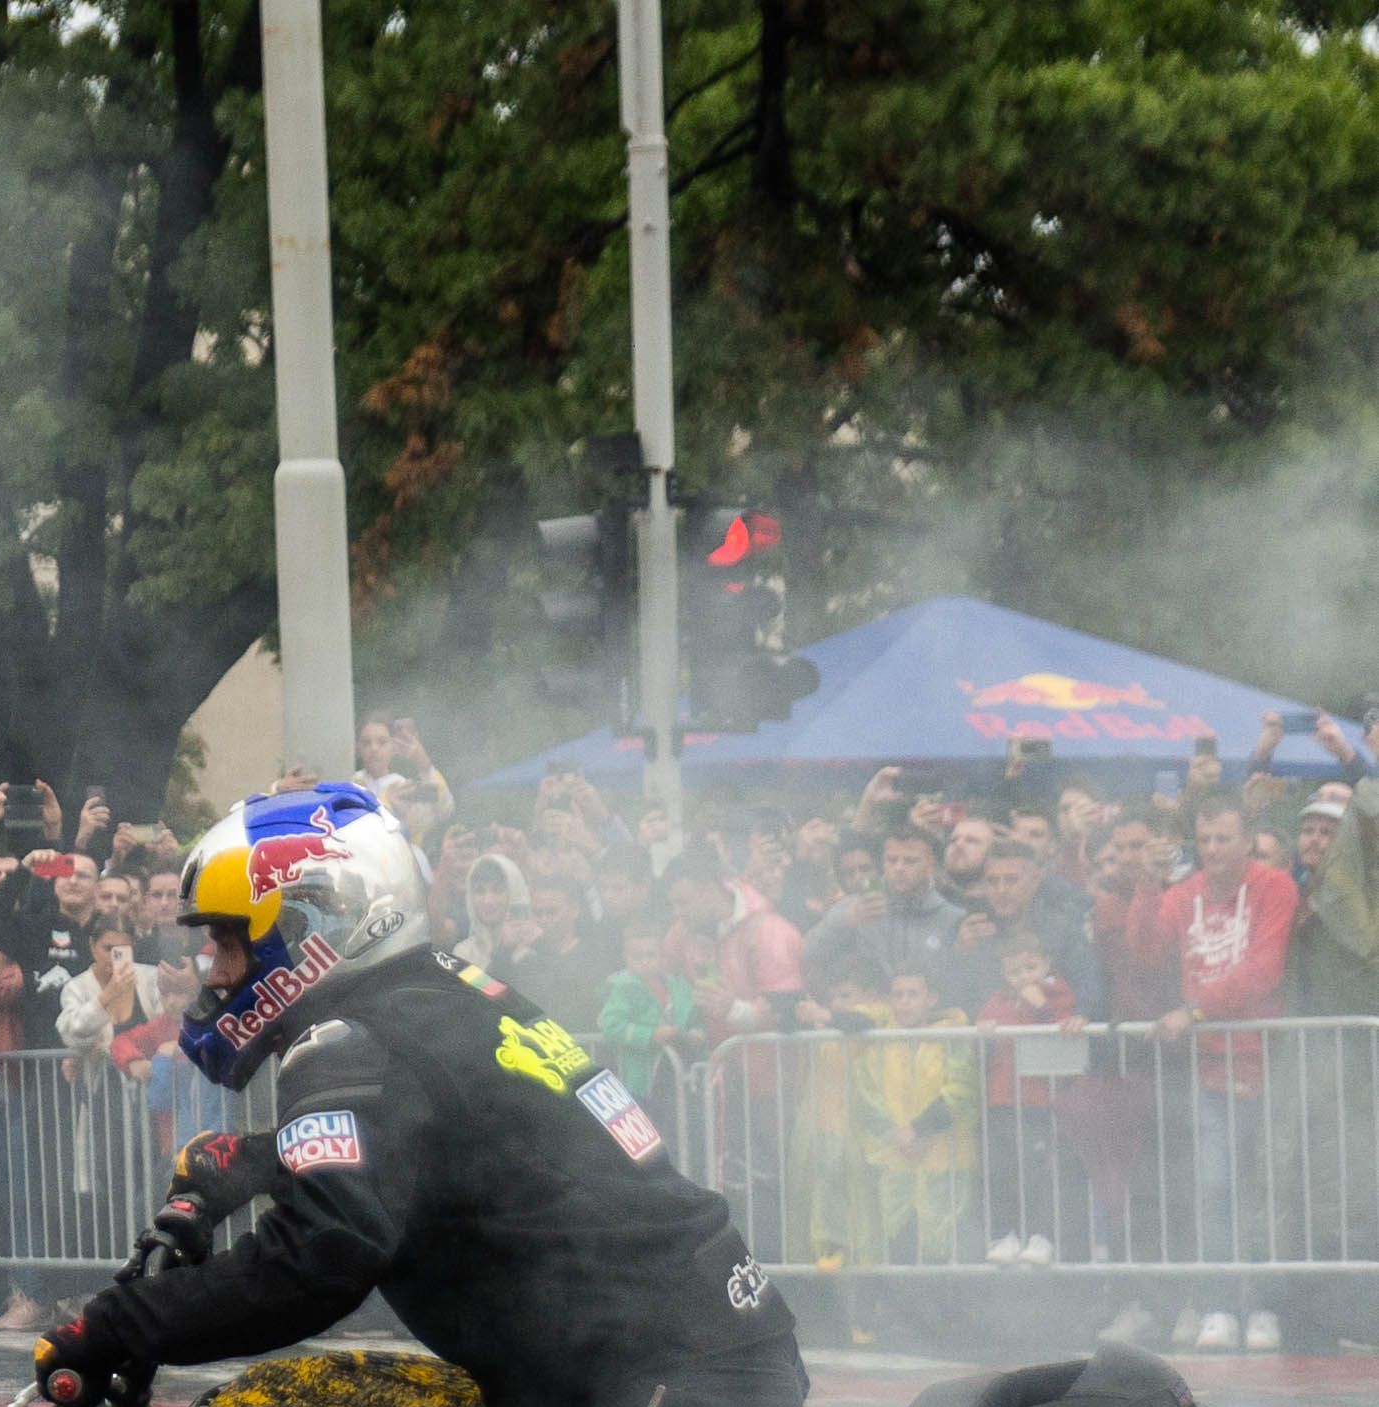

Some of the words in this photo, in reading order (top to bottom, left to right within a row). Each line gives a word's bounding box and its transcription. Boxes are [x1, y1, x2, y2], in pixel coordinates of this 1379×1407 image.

[216, 980, 284, 1050] Red
[264, 931, 341, 1006] Bull
[281, 1114, 351, 1150] LIQUI
[283, 1137, 354, 1168] MOLY
